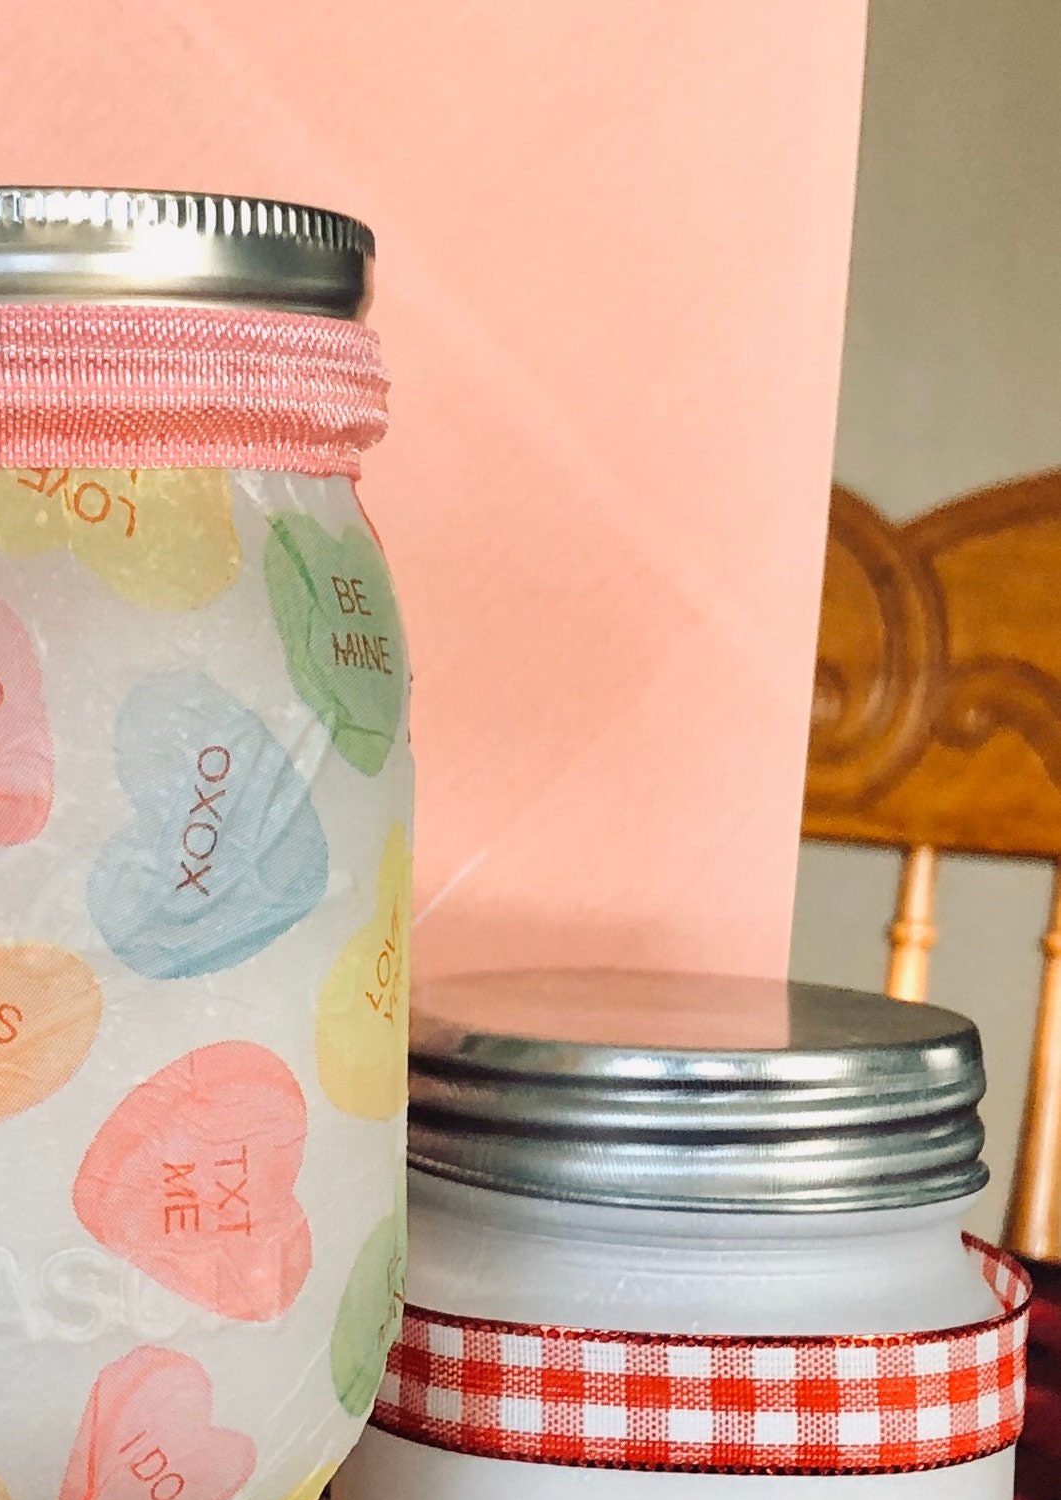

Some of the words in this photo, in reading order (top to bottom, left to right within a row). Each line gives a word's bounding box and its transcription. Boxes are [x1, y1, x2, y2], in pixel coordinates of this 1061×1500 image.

[330, 575, 373, 616] BE
[331, 632, 393, 675] MINE
[175, 745, 231, 896] XOXO
[162, 1162, 199, 1234] ME
[214, 1144, 251, 1237] TXT
[118, 1429, 147, 1453] I
